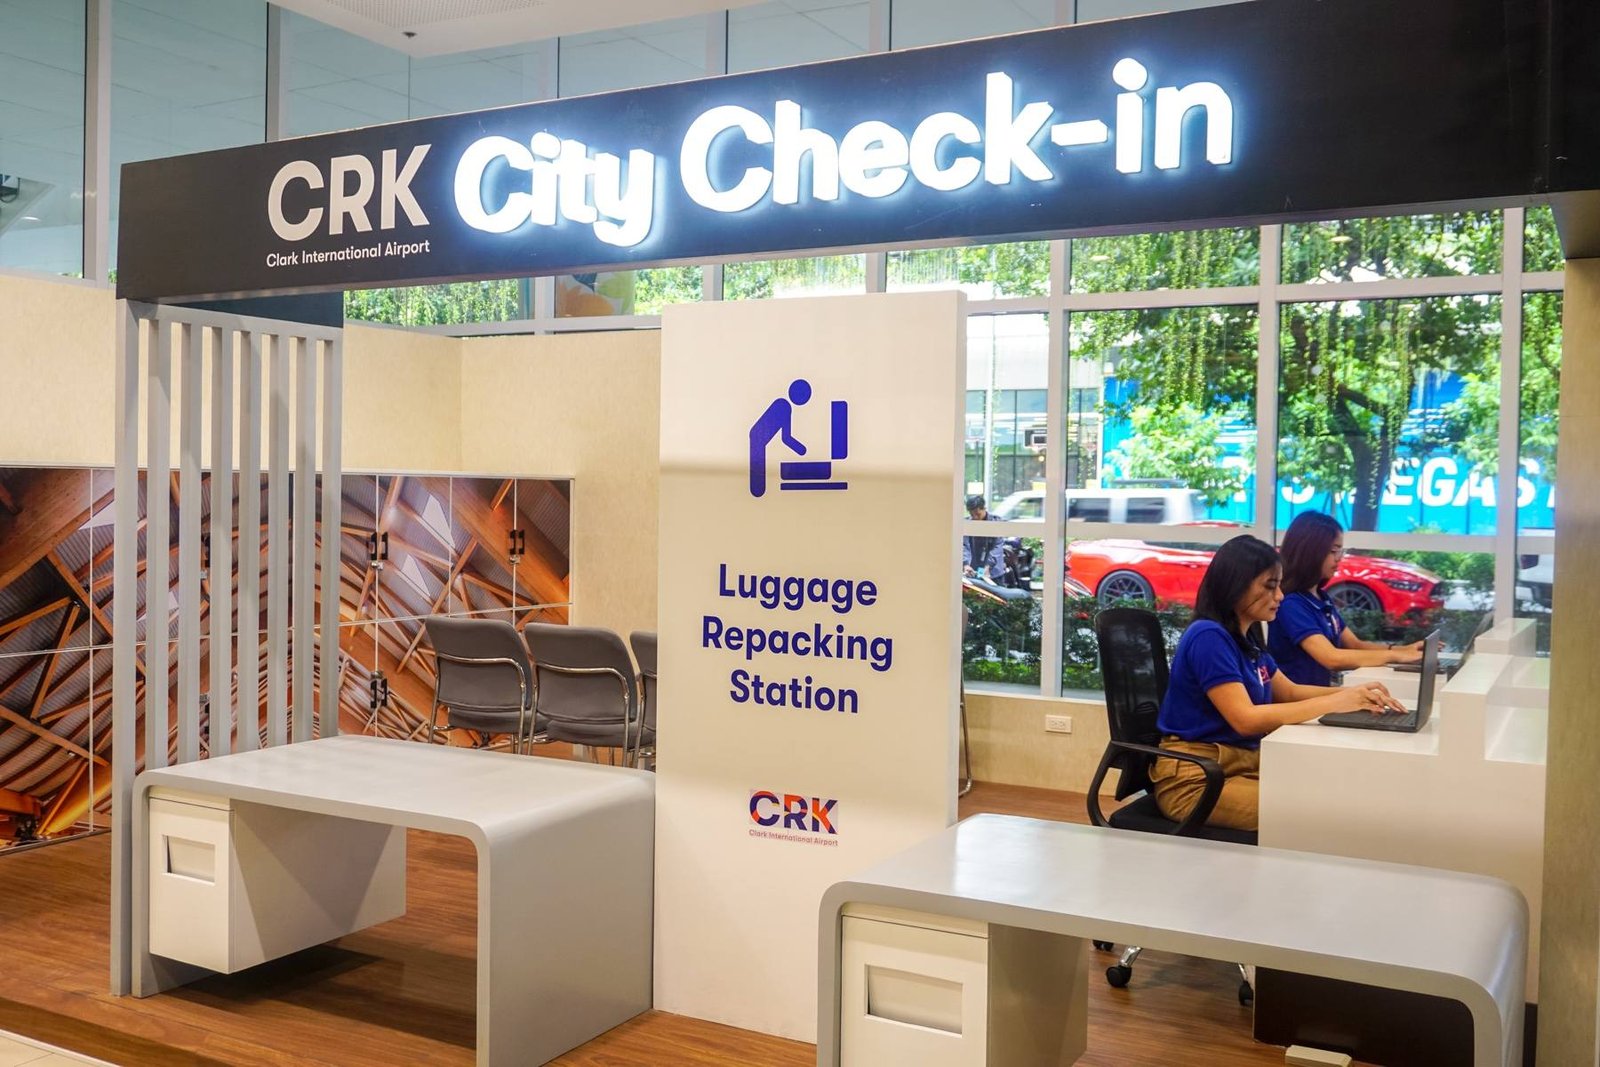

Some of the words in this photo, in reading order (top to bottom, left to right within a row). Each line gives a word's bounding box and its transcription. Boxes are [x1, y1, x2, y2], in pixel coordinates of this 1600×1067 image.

[453, 130, 655, 247] City
[680, 57, 1234, 212] Check-in
[267, 143, 432, 242] CRK
[266, 251, 299, 268] Clark
[302, 243, 381, 264] International
[384, 239, 431, 258] Airport
[719, 563, 878, 614] Luggage
[702, 615, 894, 672] Repacking
[730, 669, 859, 714] Station
[749, 790, 839, 835] CRK
[748, 829, 767, 838] Clark
[768, 831, 813, 844] International
[813, 837, 839, 847] Airport
